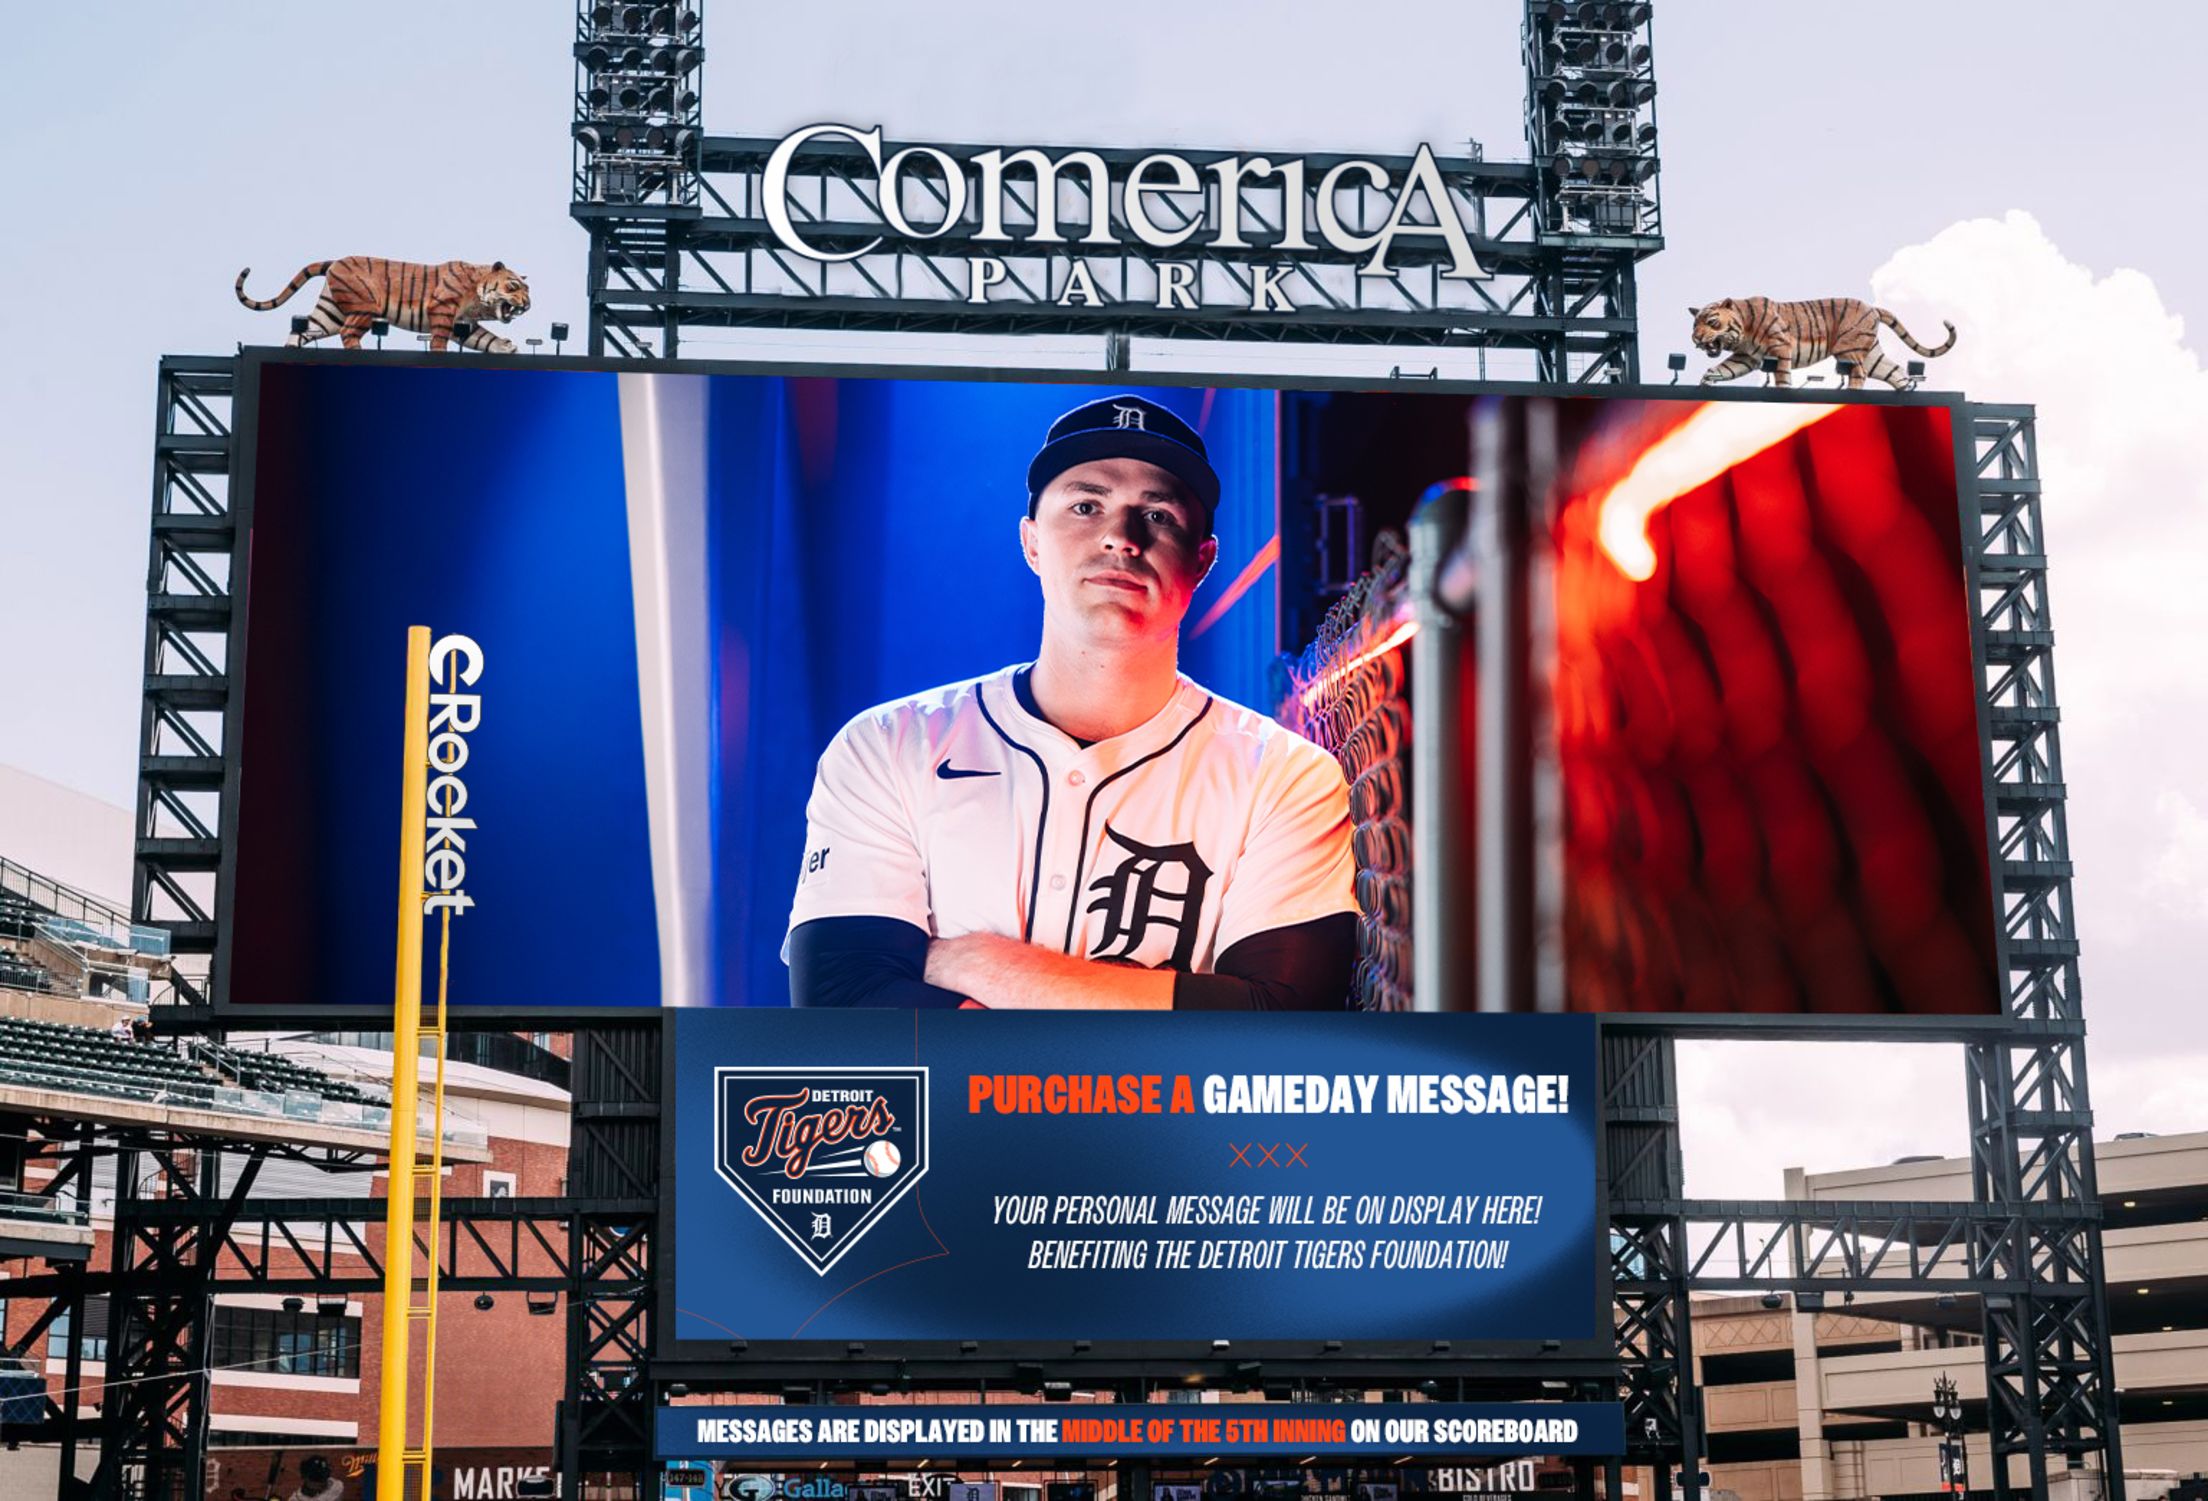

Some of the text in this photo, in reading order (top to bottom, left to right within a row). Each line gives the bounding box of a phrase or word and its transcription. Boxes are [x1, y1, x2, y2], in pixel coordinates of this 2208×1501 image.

[967, 257, 1296, 312] PARK
[812, 1089, 874, 1103] DETROIT
[969, 1074, 1569, 1114] PURCHASE A GAMEDAY MESSAGE!
[742, 1087, 896, 1180] Tigers
[772, 1188, 873, 1205] FOUNDATION
[993, 1195, 1543, 1225] YOUR PERSONAL MESSAGE WILL BE ON DISPLAY HERE!
[1027, 1239, 1510, 1270] BENEFITING THE DETROIT TIGERS FOUNDATION!
[697, 1418, 1578, 1444] MESSAGES ARE DISPLAYED IN THE MIDDLE OF THE 5TH INNING ON OUR SCOREBOARD
[341, 1453, 377, 1477] Mill
[783, 1478, 849, 1498] Galla
